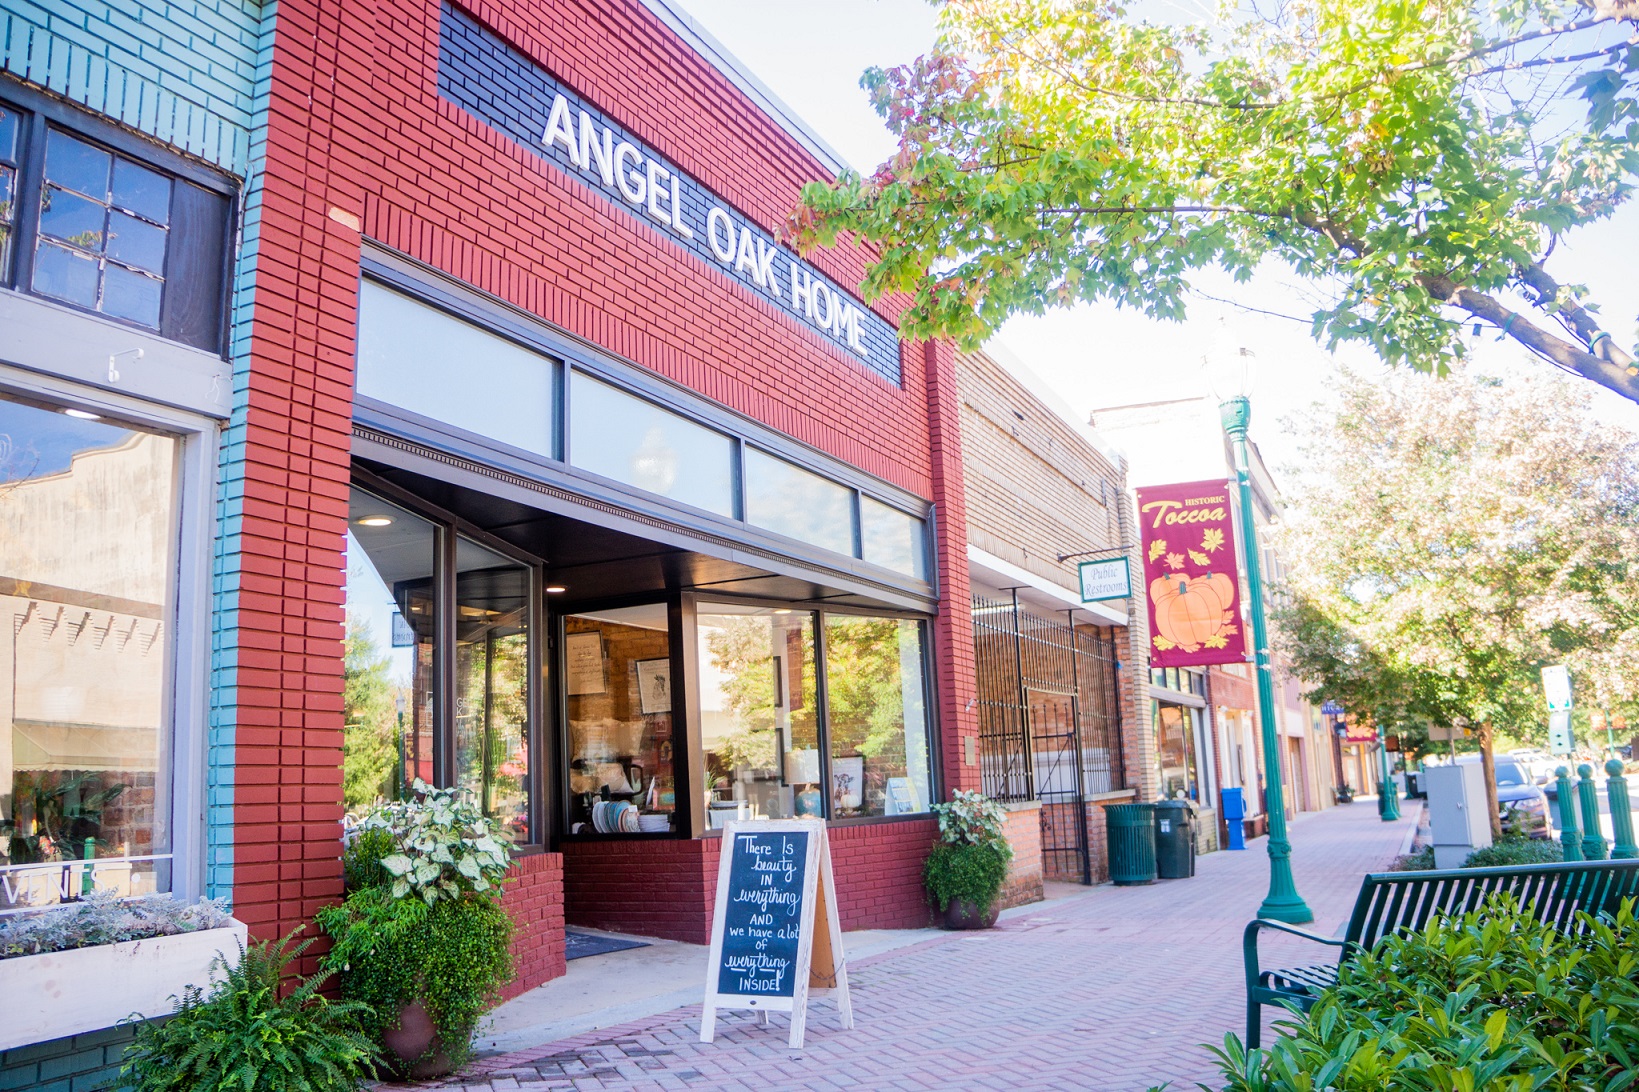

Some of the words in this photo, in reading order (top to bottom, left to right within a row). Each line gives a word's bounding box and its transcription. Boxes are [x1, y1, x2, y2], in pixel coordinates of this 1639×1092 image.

[541, 93, 694, 240] ANGEL
[706, 206, 781, 298] OAK
[790, 261, 868, 357] HOME
[1184, 495, 1226, 507] HISTORIC
[1141, 500, 1227, 529] Toccoa
[1090, 563, 1118, 581] Public
[1084, 582, 1128, 597] Restrooms
[737, 835, 772, 855] There
[782, 835, 794, 855] Is
[751, 854, 797, 882] beauty
[760, 873, 773, 886] IN
[733, 886, 801, 916] everything
[749, 913, 774, 926] AND
[729, 926, 745, 937] we
[748, 926, 773, 938] have
[755, 938, 768, 951] of
[724, 951, 791, 980] everything
[739, 969, 781, 992] INSIDE!
